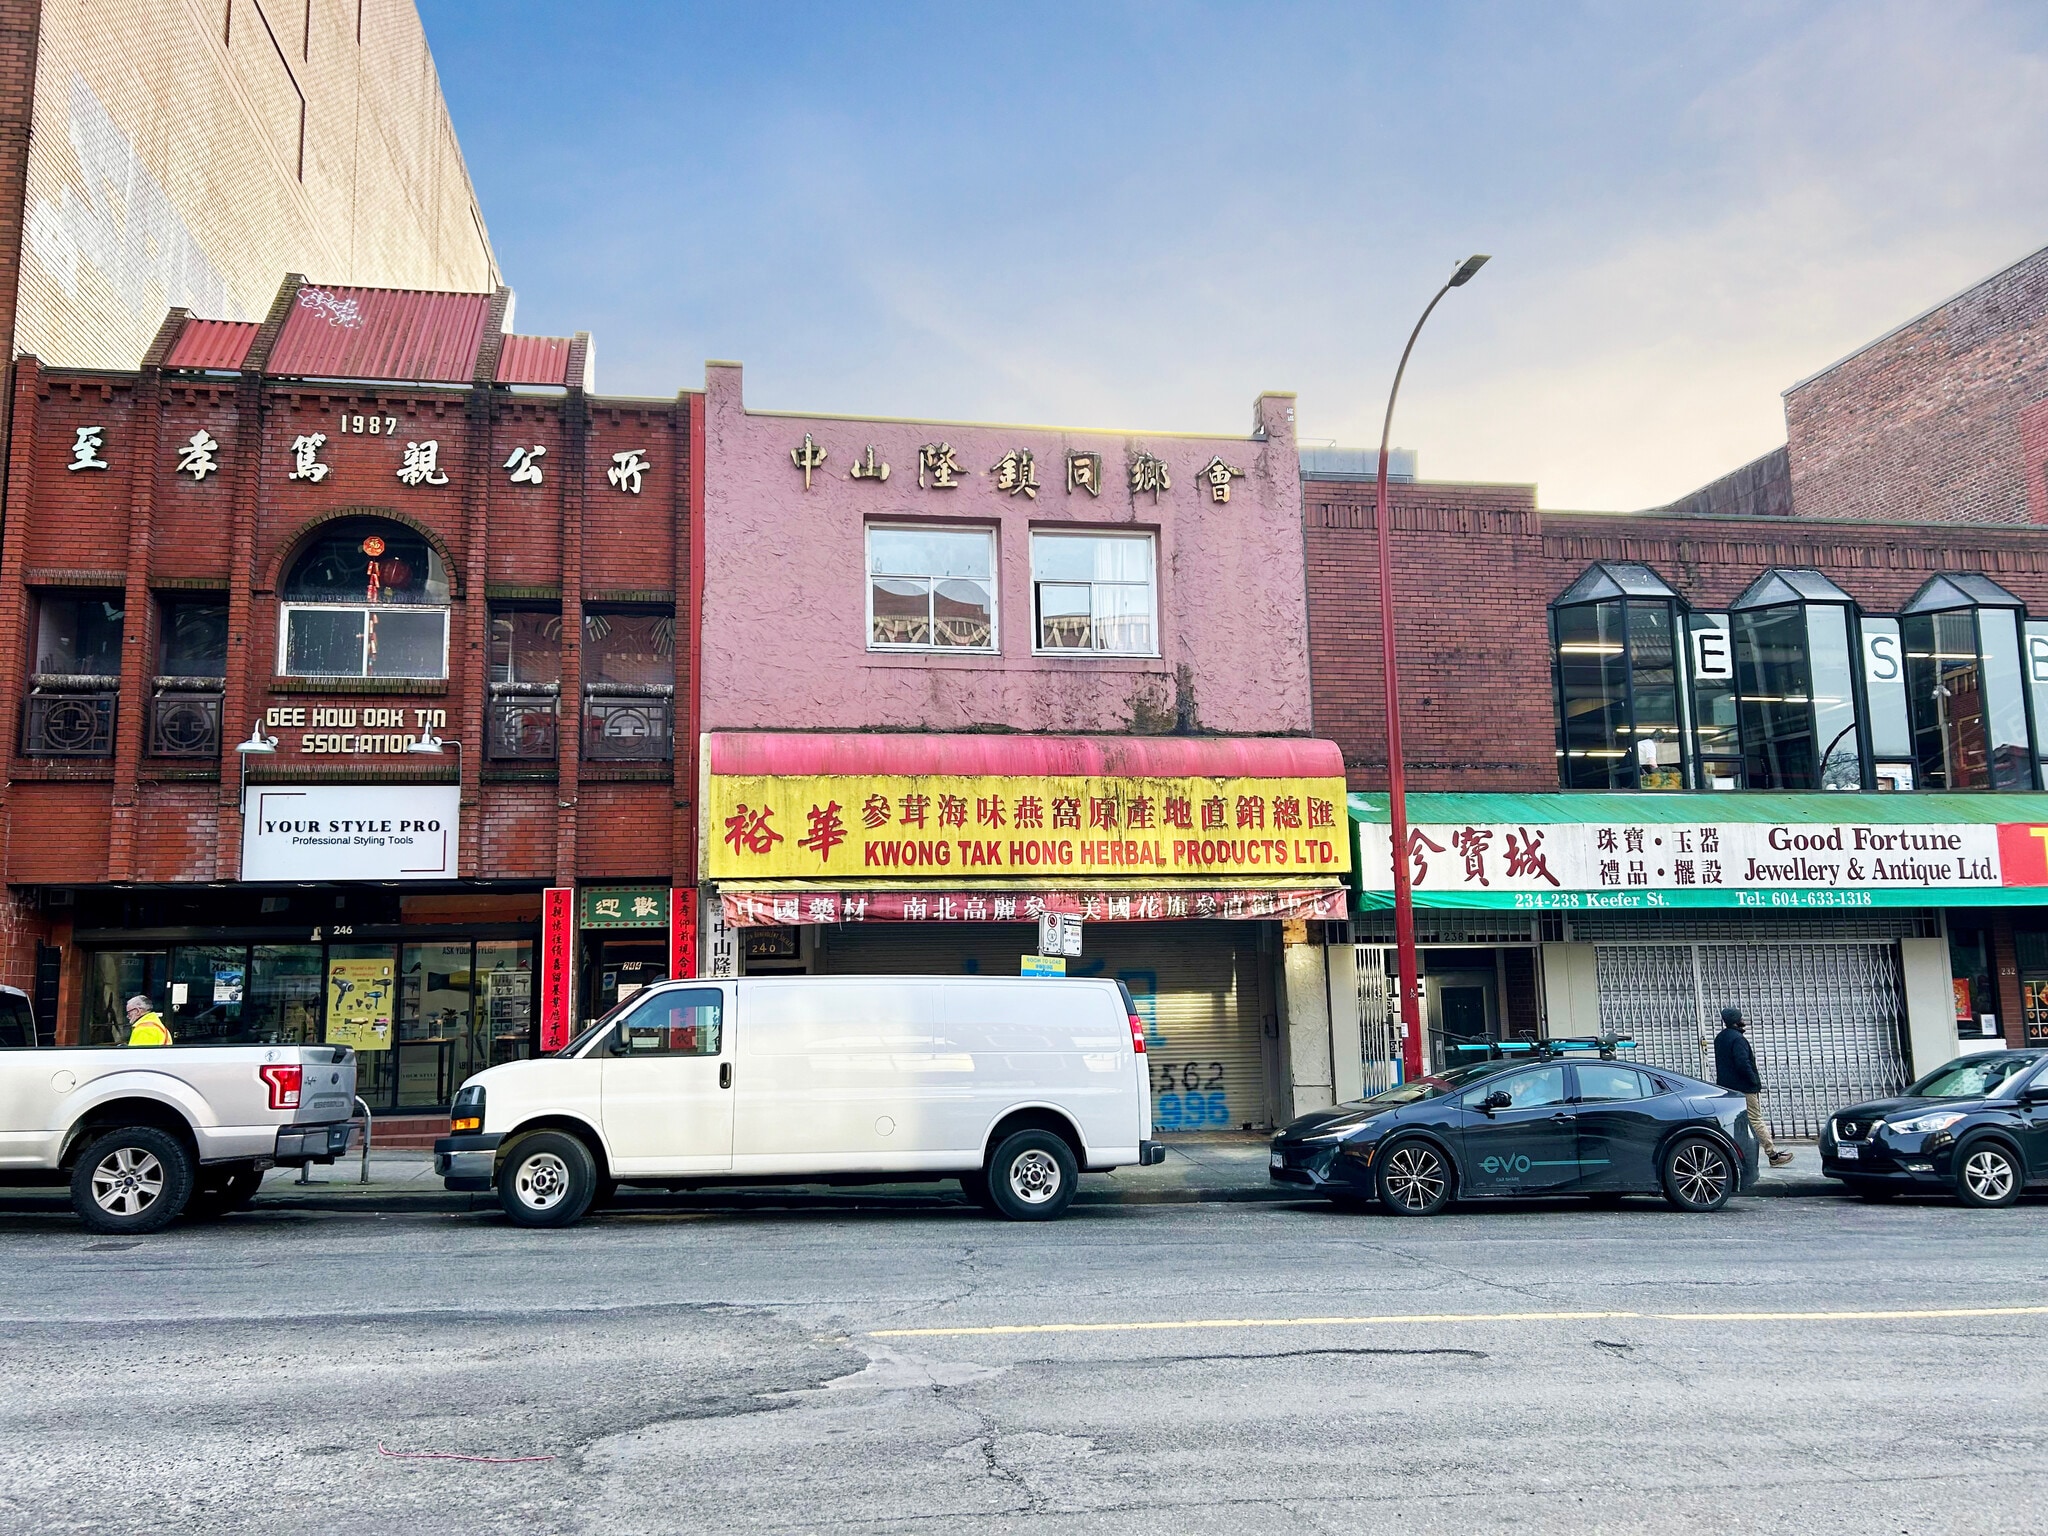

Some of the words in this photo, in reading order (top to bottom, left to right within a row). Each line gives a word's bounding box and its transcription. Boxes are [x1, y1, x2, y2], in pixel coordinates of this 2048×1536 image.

[340, 414, 397, 436] 1987
[1871, 637, 1898, 680] S
[266, 708, 305, 727] GEE
[312, 708, 356, 727] HOW
[363, 709, 404, 727] OAK
[265, 820, 321, 833] YOUR
[329, 820, 392, 833] STYLE
[400, 819, 441, 832] PRO
[724, 800, 848, 863] 裕華
[292, 836, 351, 845] Professional
[353, 836, 385, 846] Styling
[388, 836, 413, 845] Tools
[1768, 827, 1844, 851] Good
[1852, 827, 1962, 851] Fortune
[864, 840, 950, 867] KWONG
[958, 840, 1002, 866] TAK
[1009, 840, 1073, 866] HONG
[1080, 840, 1166, 865] HERBAL
[1173, 839, 1288, 865] PRODUCTS
[1295, 839, 1339, 864] LTD.
[1744, 857, 1840, 886] Jewellery
[1847, 857, 1866, 881] &
[1872, 857, 1951, 885] Antique
[1958, 856, 1998, 880] Ltd.
[1514, 894, 1580, 908] 234-238
[1586, 893, 1640, 907] Keefer
[1646, 892, 1670, 906] St.
[1735, 891, 1766, 906] Tel:
[1771, 891, 1872, 905] 604-633-1318
[333, 925, 353, 935] 246
[1443, 932, 1464, 942] 238
[752, 943, 776, 953] 240
[2001, 967, 2016, 976] 232
[1483, 1152, 1531, 1173] evo
